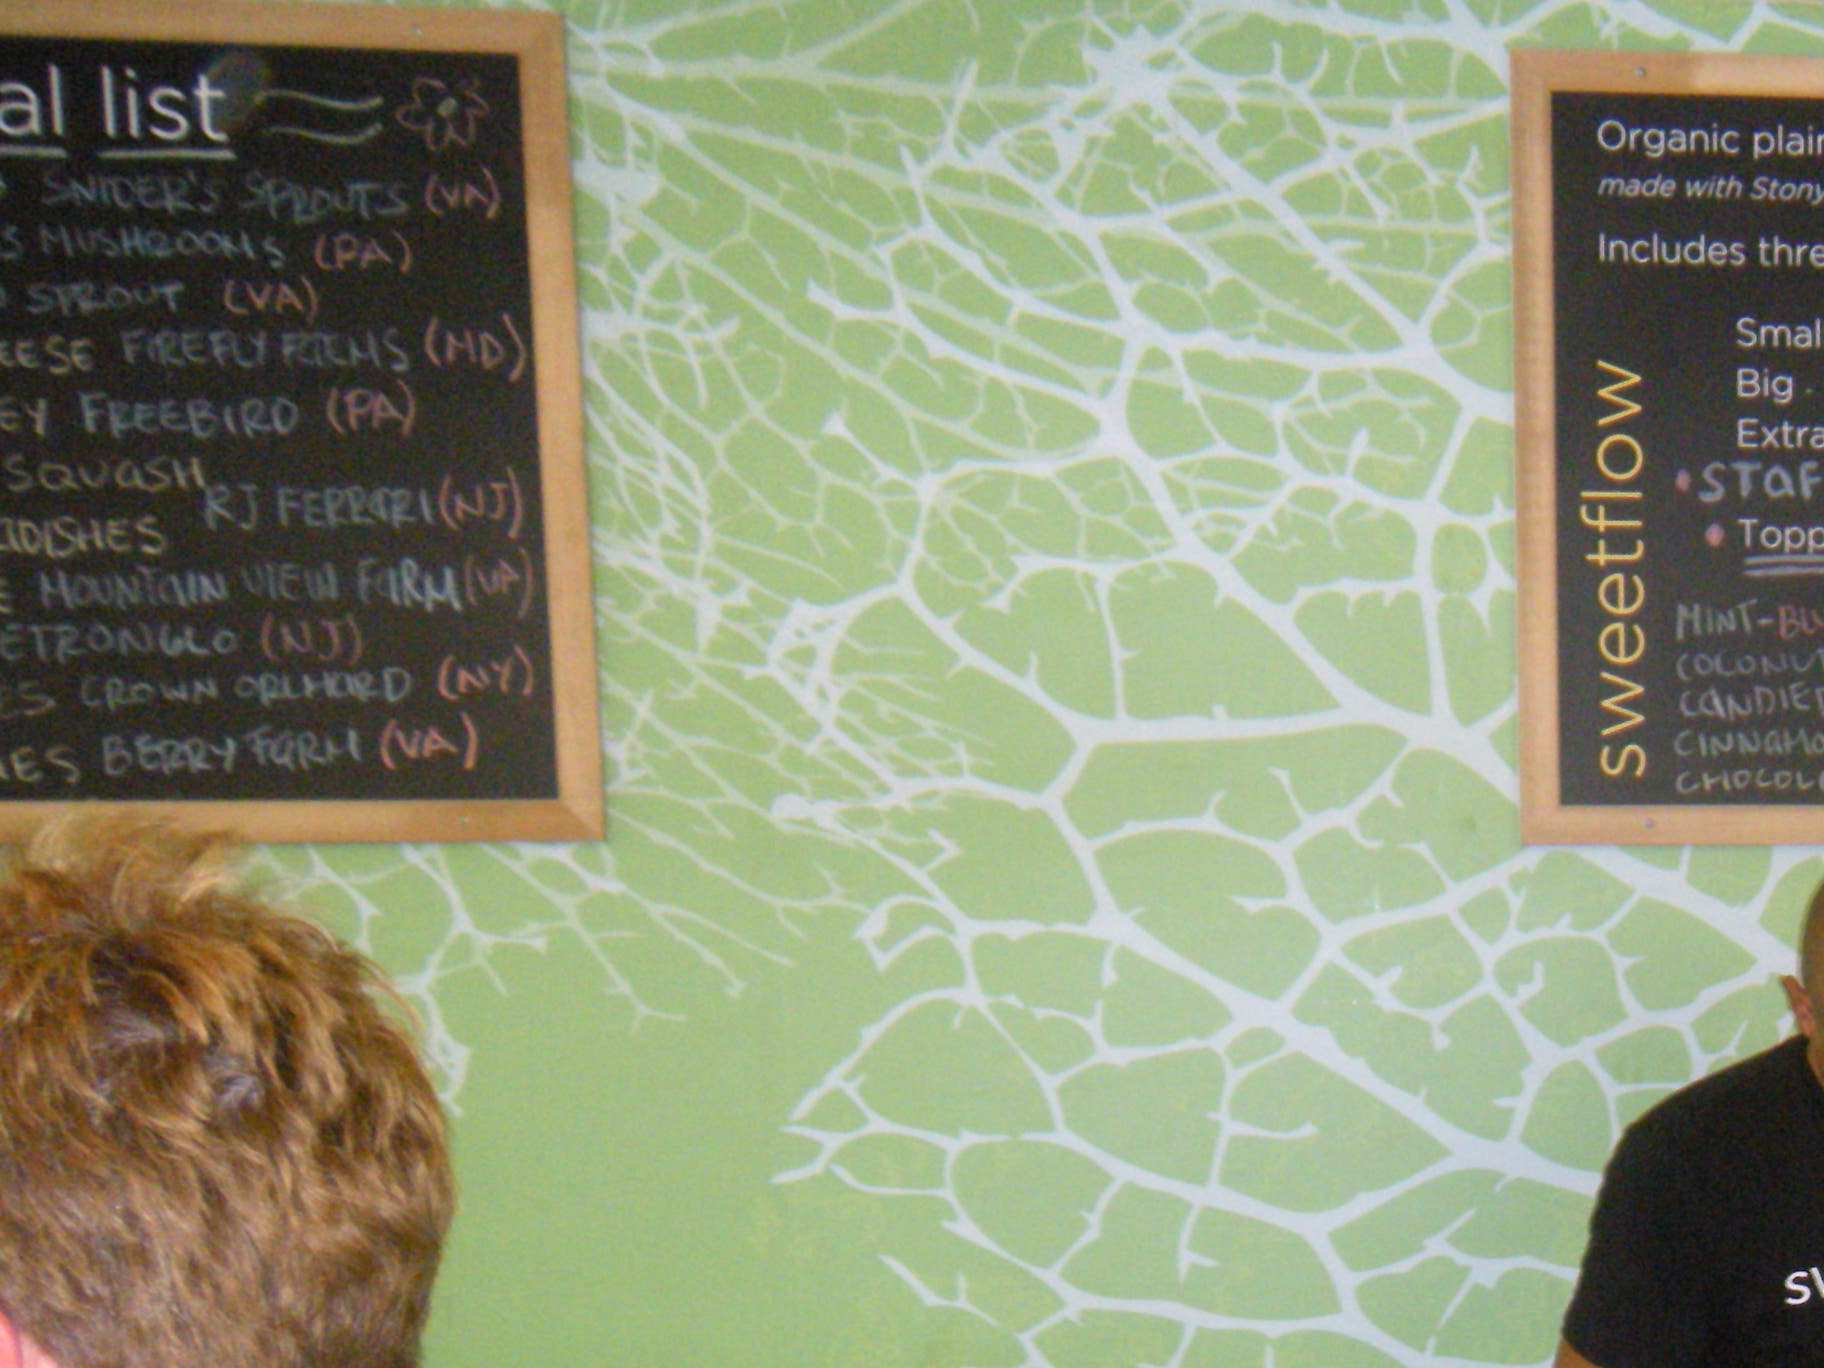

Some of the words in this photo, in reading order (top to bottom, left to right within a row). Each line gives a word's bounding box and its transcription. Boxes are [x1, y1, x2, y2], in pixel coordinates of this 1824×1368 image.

[101, 64, 229, 143] list
[1597, 119, 1741, 158] Organic
[1598, 174, 1676, 197] made
[1685, 175, 1743, 199] with
[1598, 232, 1746, 266] Includes
[224, 276, 318, 323] (VA)
[327, 380, 416, 434] (PA)
[1736, 368, 1794, 404] Big
[1580, 359, 1647, 777] sweetflow
[381, 712, 477, 771] (VA)
